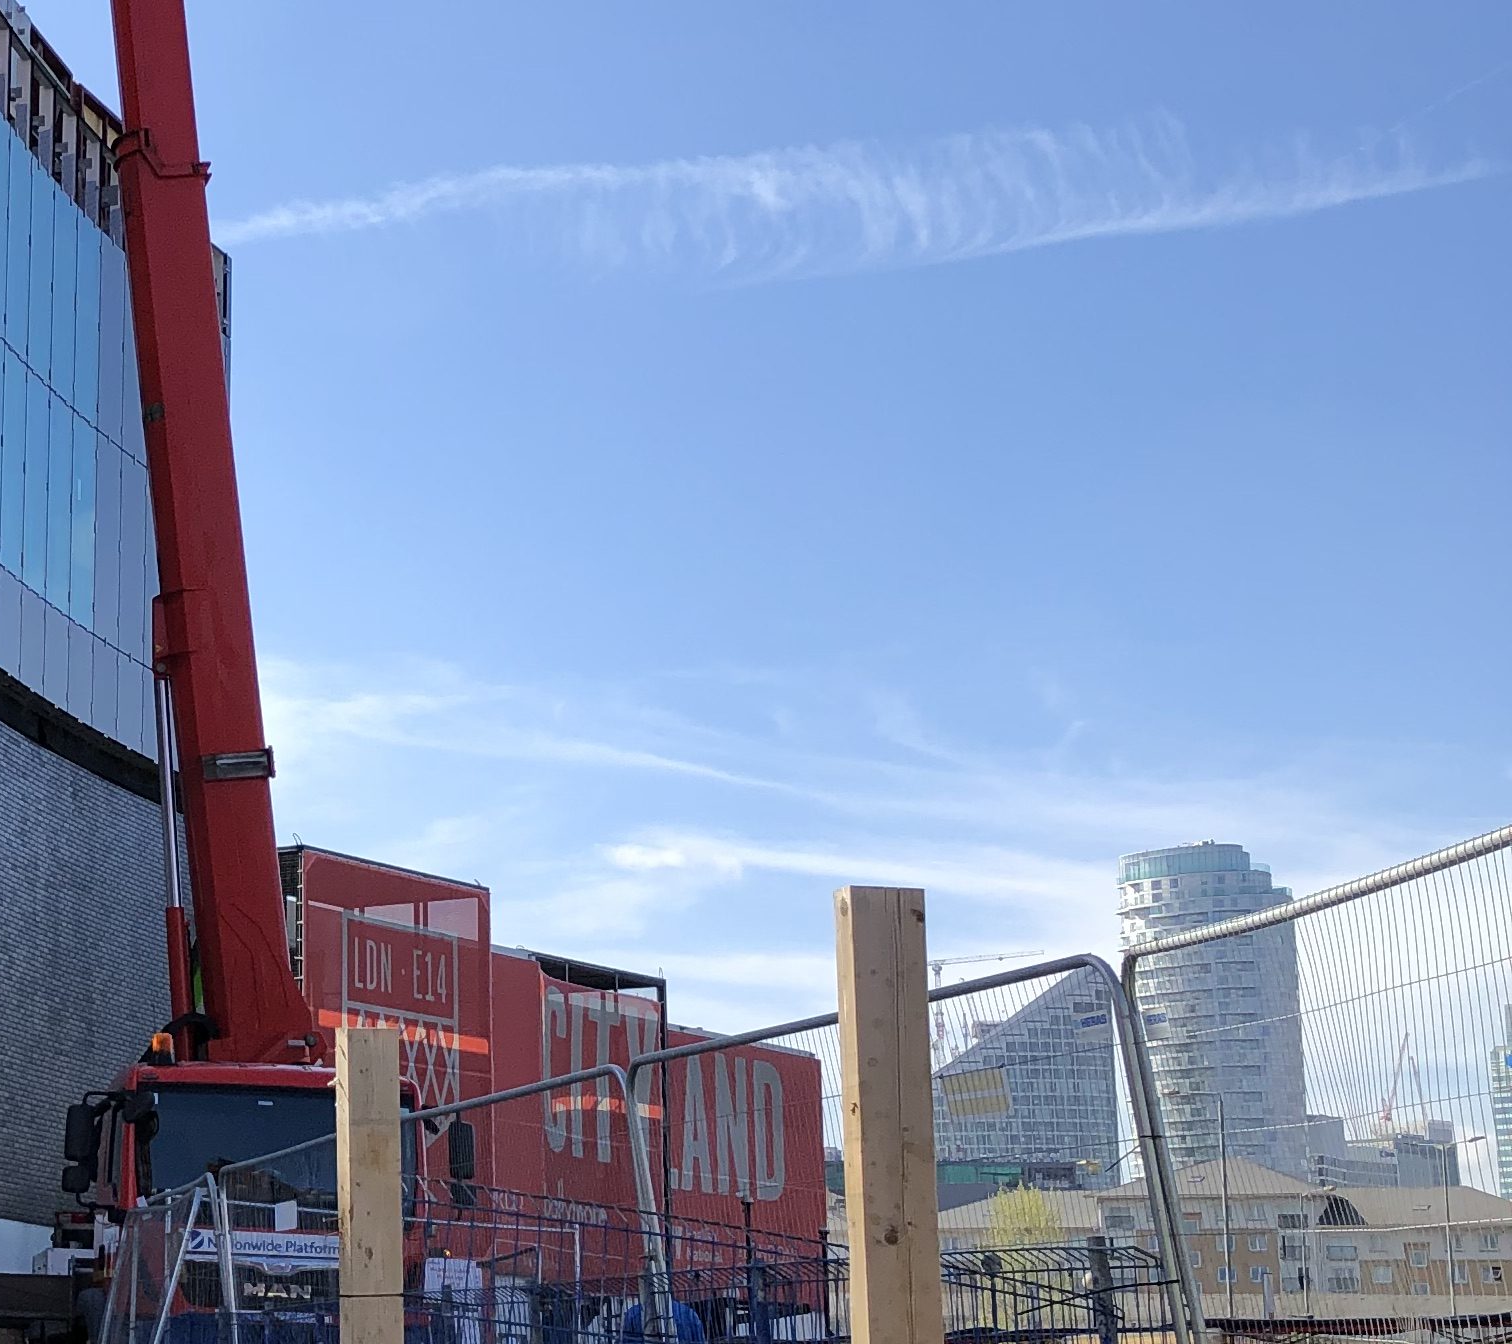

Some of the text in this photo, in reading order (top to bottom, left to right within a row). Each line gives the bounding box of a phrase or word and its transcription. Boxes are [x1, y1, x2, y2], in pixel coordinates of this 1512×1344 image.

[354, 937, 447, 1004] LDN E14
[542, 986, 785, 1202] CITY AND
[208, 1236, 339, 1254] Nionwide Platform
[244, 1281, 312, 1299] MAN
